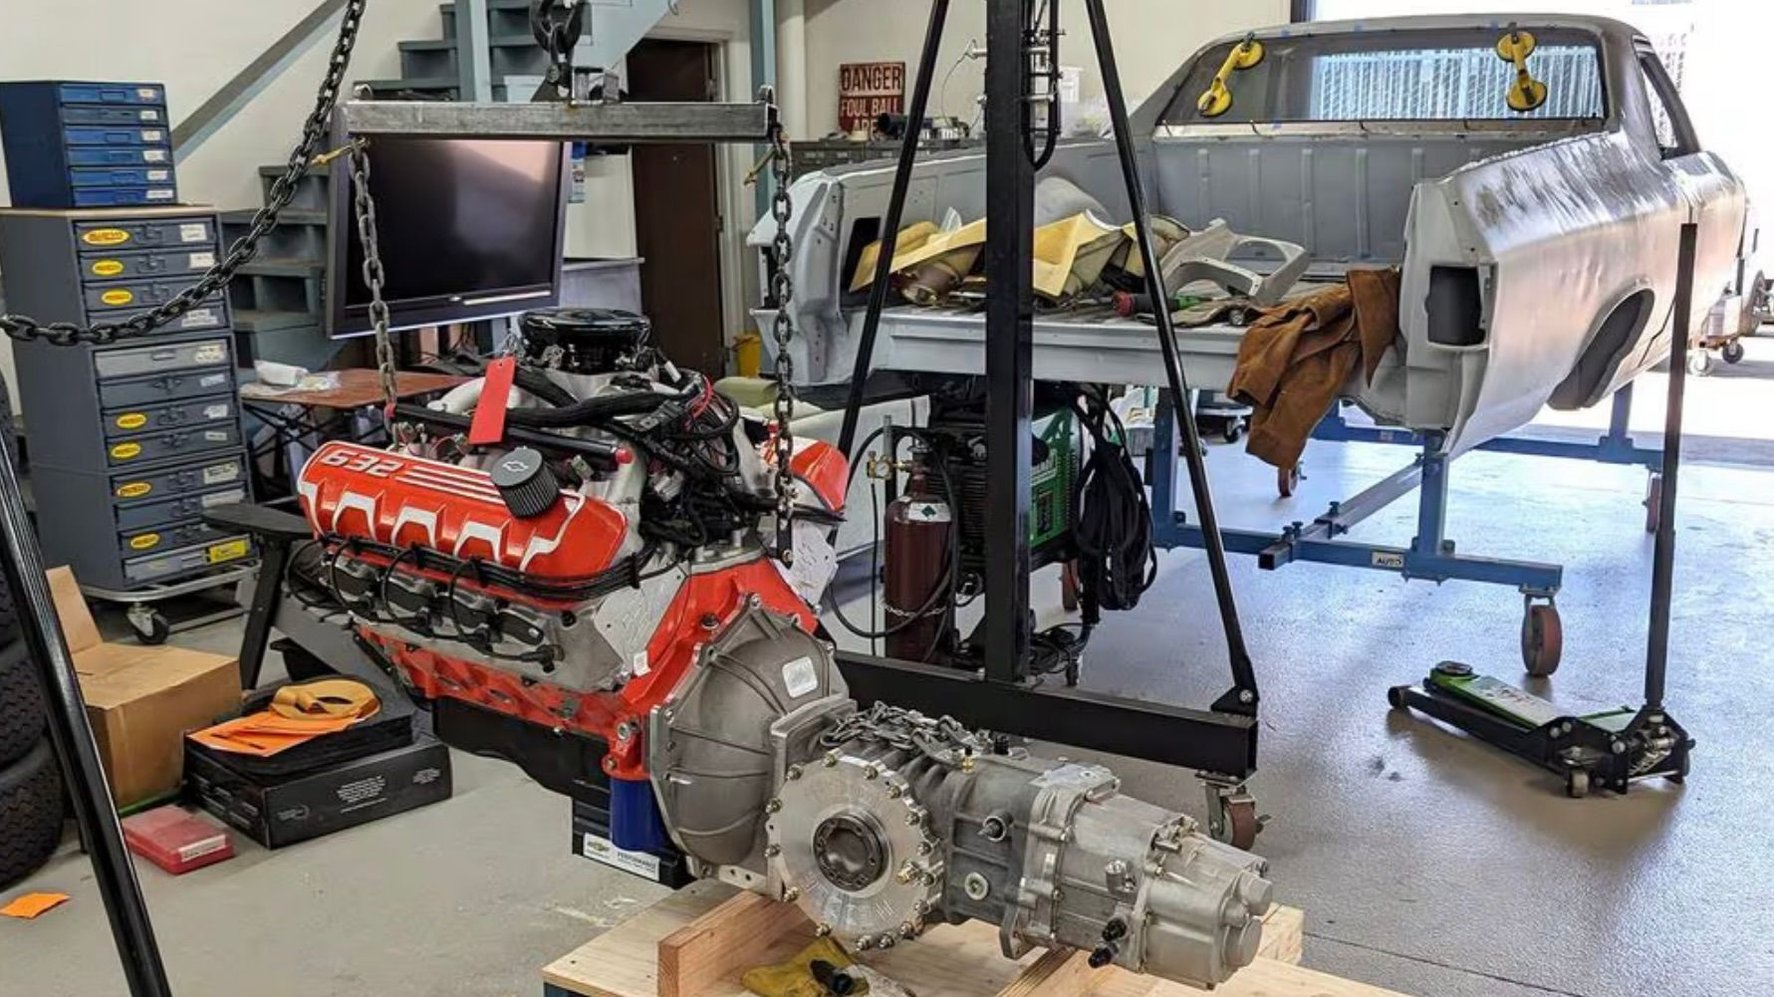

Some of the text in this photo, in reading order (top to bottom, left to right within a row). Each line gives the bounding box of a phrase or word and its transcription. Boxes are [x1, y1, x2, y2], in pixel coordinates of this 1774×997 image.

[841, 66, 901, 91] DANGER
[841, 98, 898, 117] FOUL BALL
[321, 449, 404, 478] 632
